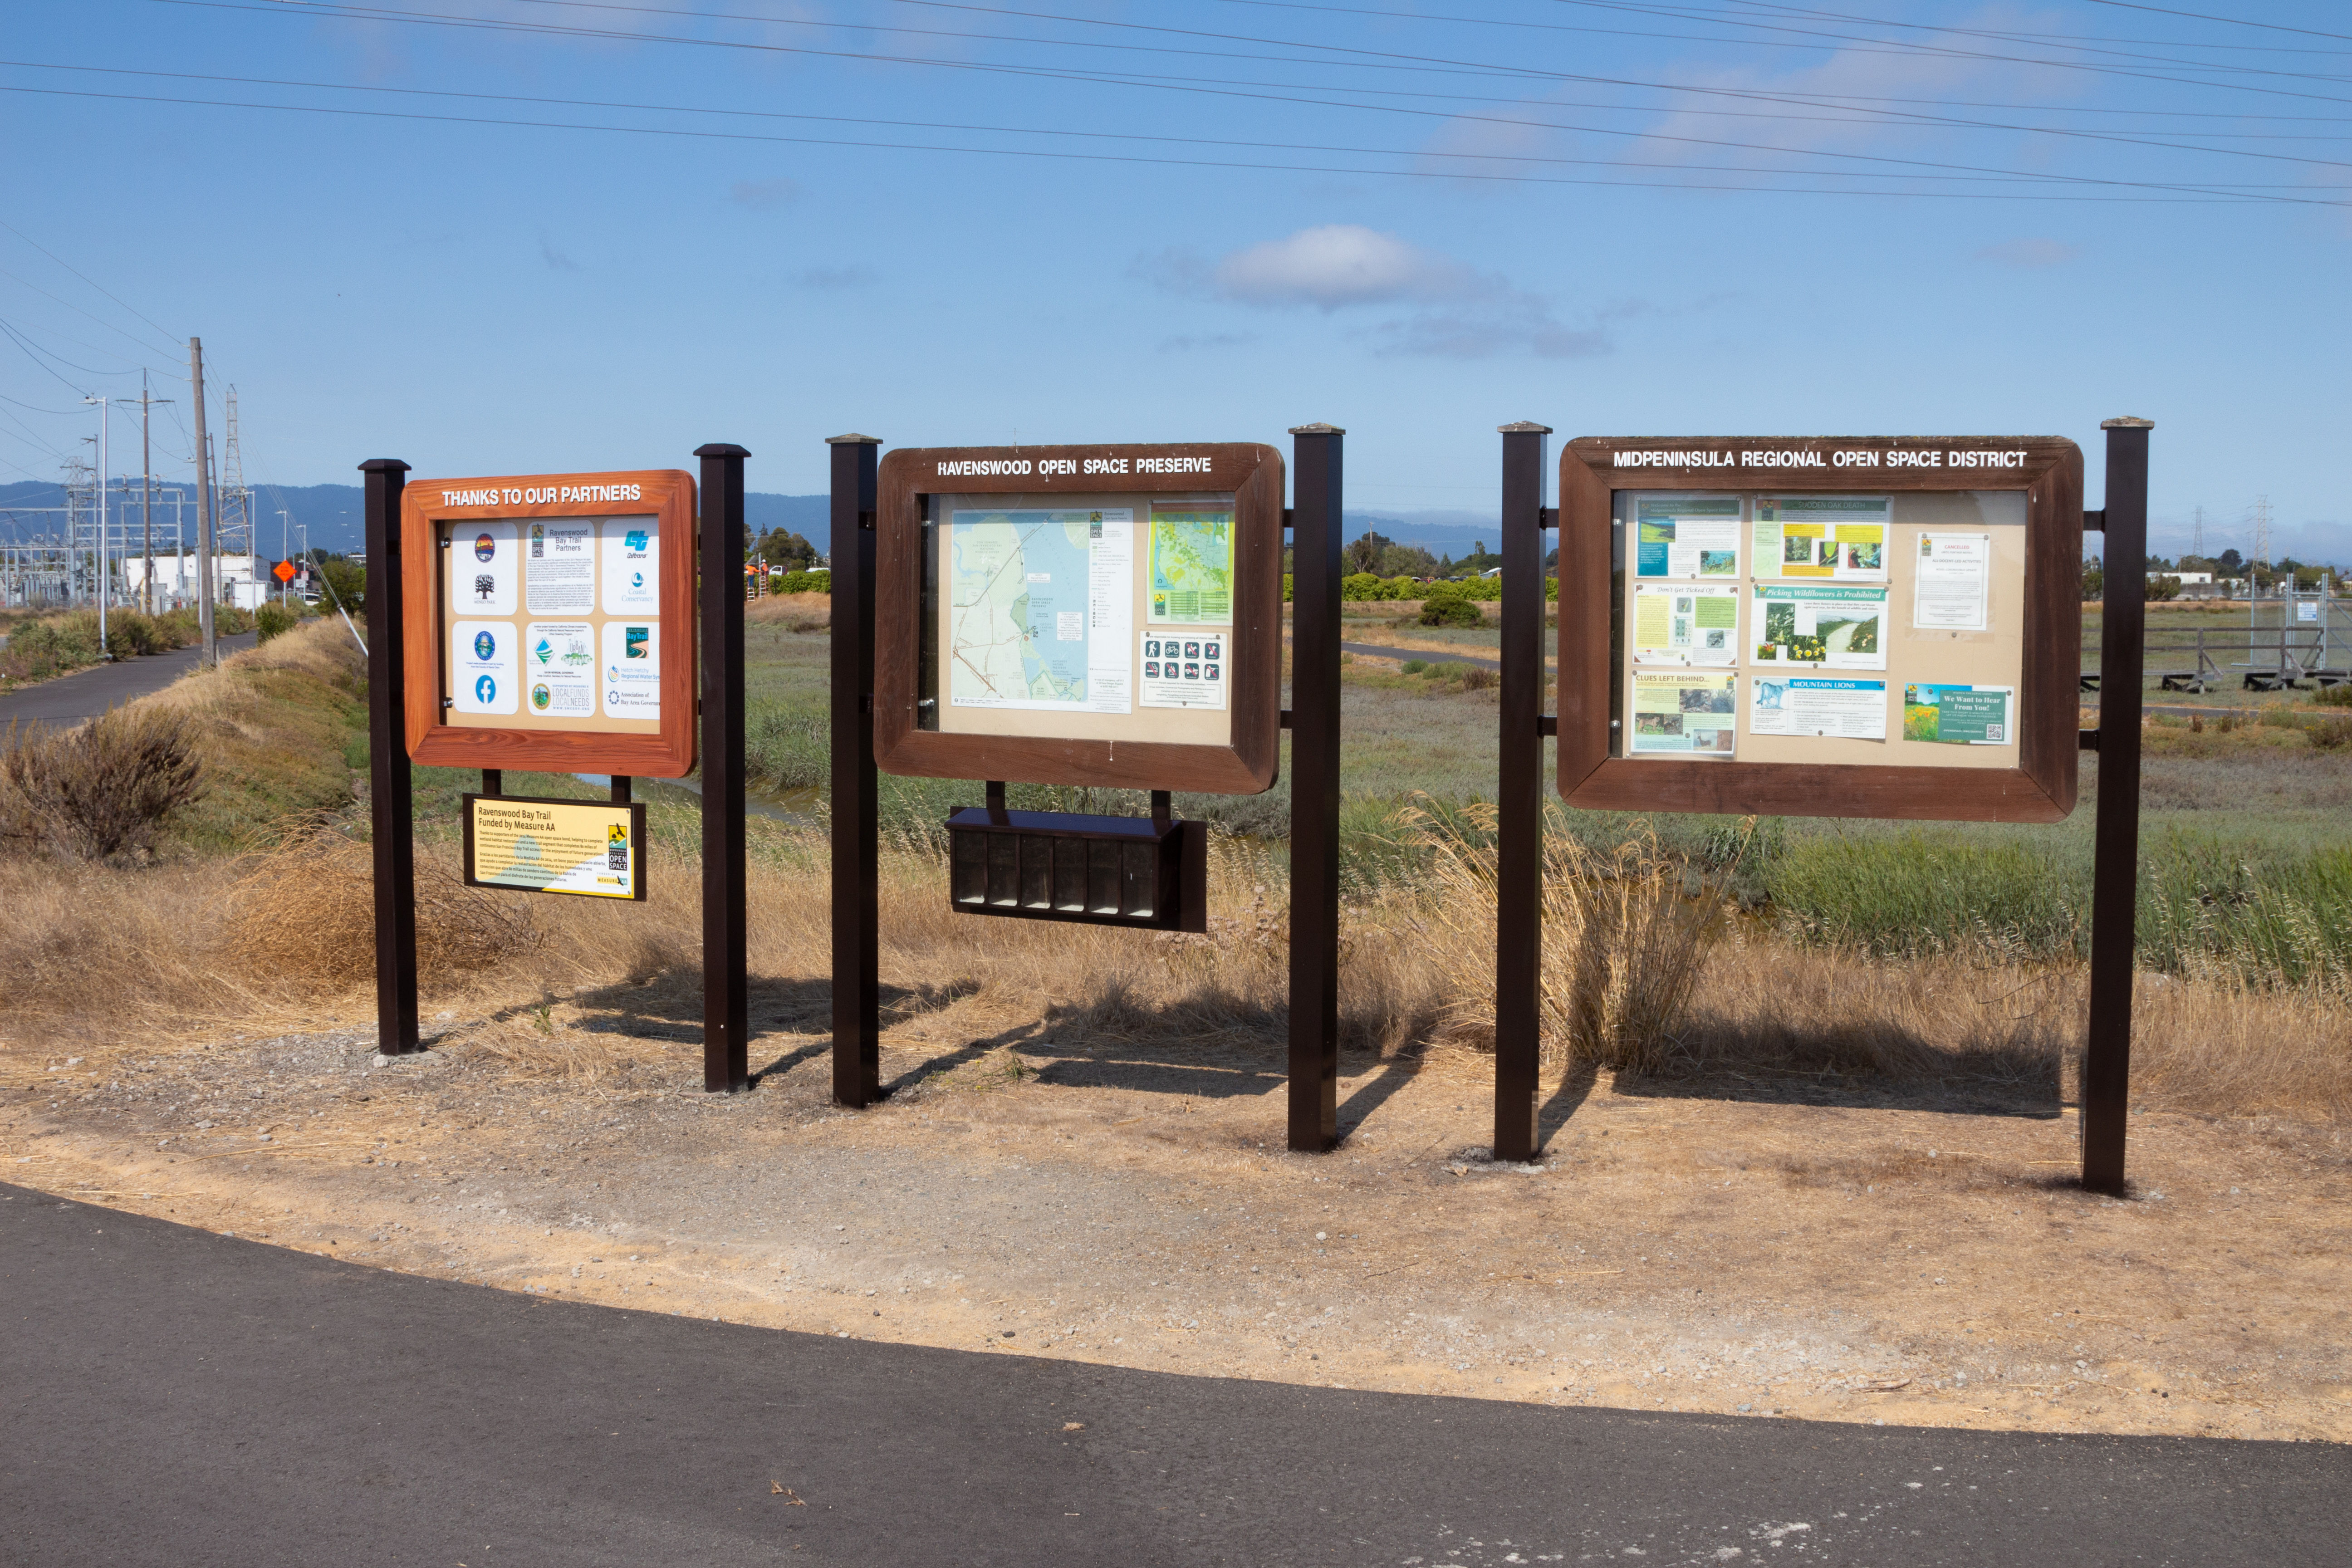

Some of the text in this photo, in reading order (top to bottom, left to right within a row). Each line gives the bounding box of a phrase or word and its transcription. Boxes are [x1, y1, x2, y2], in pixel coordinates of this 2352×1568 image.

[1613, 451, 2027, 467] MIDPENINSULA REGIONAL OPEN SPACE DISTRICT
[938, 457, 1211, 475] RAVENSWOOD OPEN SPACE PRESERVE
[442, 484, 641, 506] THANKS TO OUR PARTNERS
[622, 595, 653, 603] Conservancy
[1767, 589, 1792, 598] Picking
[1794, 590, 1835, 598] Wildflowers
[1844, 591, 1881, 599] Prohibited
[479, 807, 551, 821] Ravenswood Bay Trail
[479, 818, 555, 831] Funded by Measure AA
[609, 855, 627, 863] OPEN
